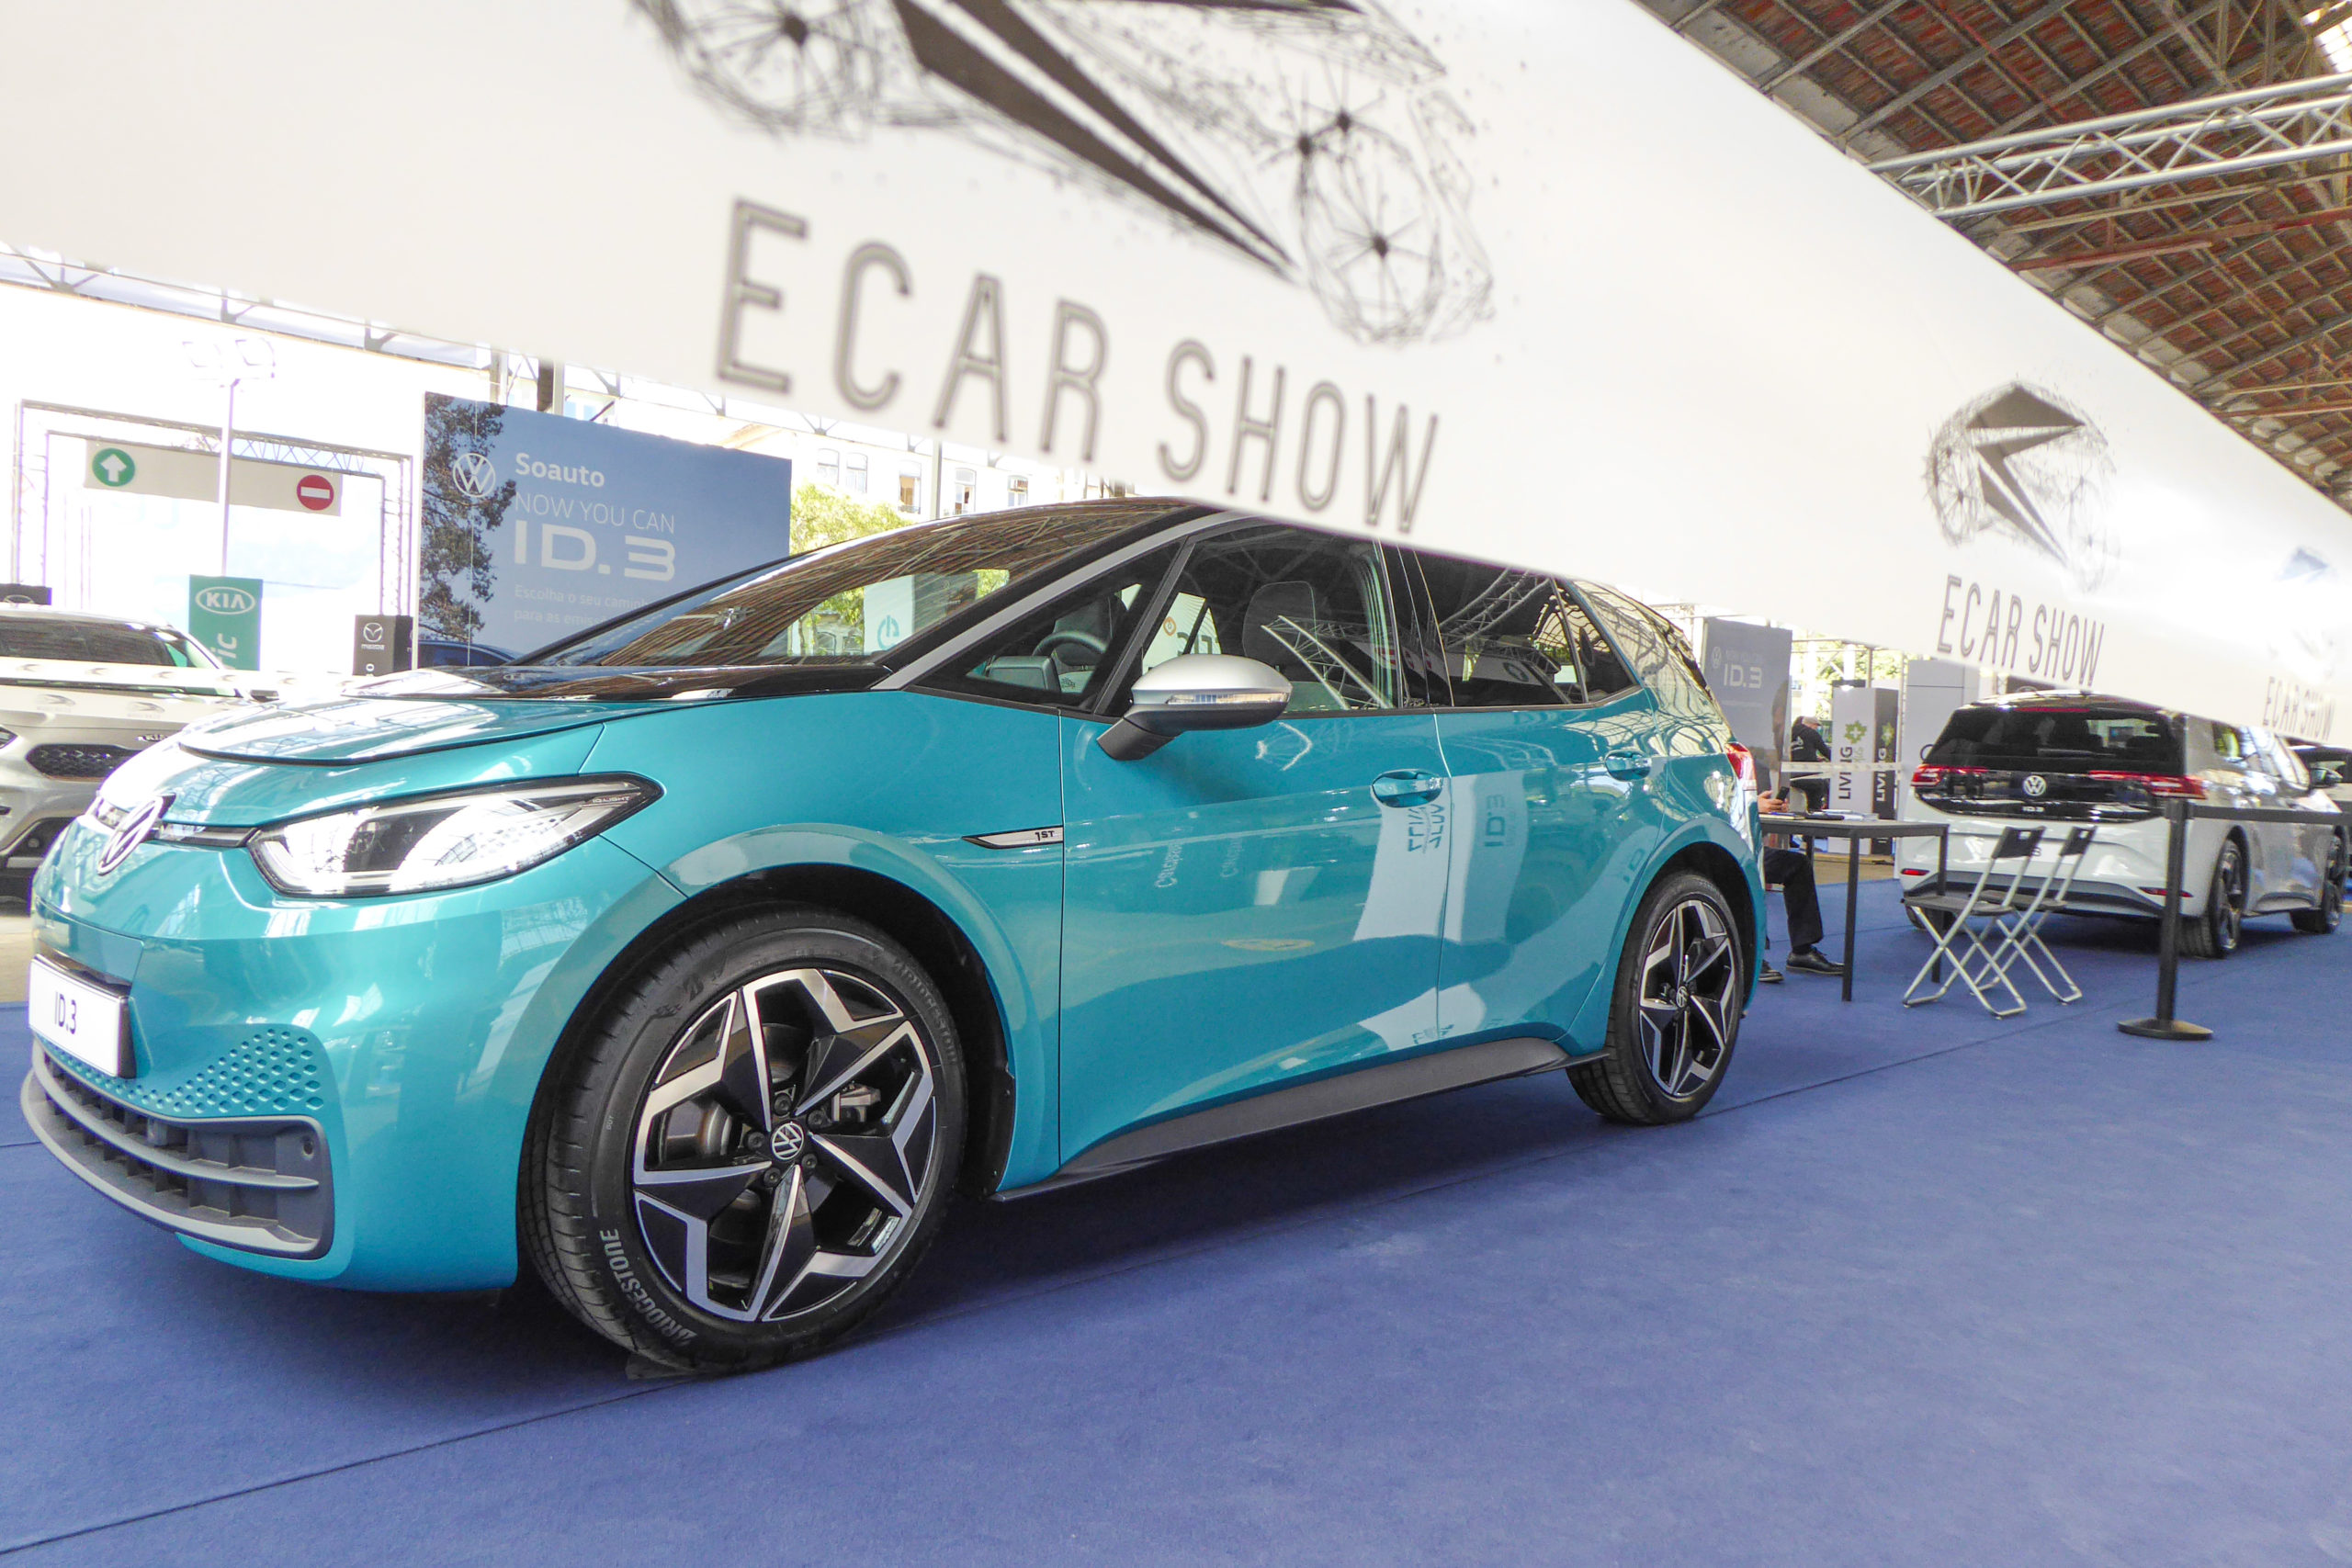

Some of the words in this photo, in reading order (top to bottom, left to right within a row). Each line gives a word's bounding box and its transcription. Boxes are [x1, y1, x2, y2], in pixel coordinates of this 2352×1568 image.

[715, 196, 1110, 464] ECAR
[1158, 338, 1439, 534] SHOW
[514, 452, 605, 487] Soauto
[514, 491, 575, 519] NOW
[580, 501, 625, 527] YOU
[632, 509, 675, 535] CAN
[514, 519, 675, 581] ID.3
[205, 592, 246, 610] KIA
[514, 584, 564, 603] Escolha
[568, 594, 577, 604] o
[580, 593, 601, 606] seu
[514, 609, 543, 623] para
[547, 611, 560, 624] as
[1937, 574, 2022, 670] ECAR
[2028, 604, 2105, 687] SHOW
[1724, 662, 1762, 689] ID.3
[2263, 675, 2300, 734] ECAR
[1838, 746, 1853, 800] LIVIG
[1876, 747, 1889, 802] LIVIG
[1035, 830, 1055, 841] 1ST
[54, 990, 77, 1034] ID.3
[599, 1228, 698, 1347] BRIDGESTONE
